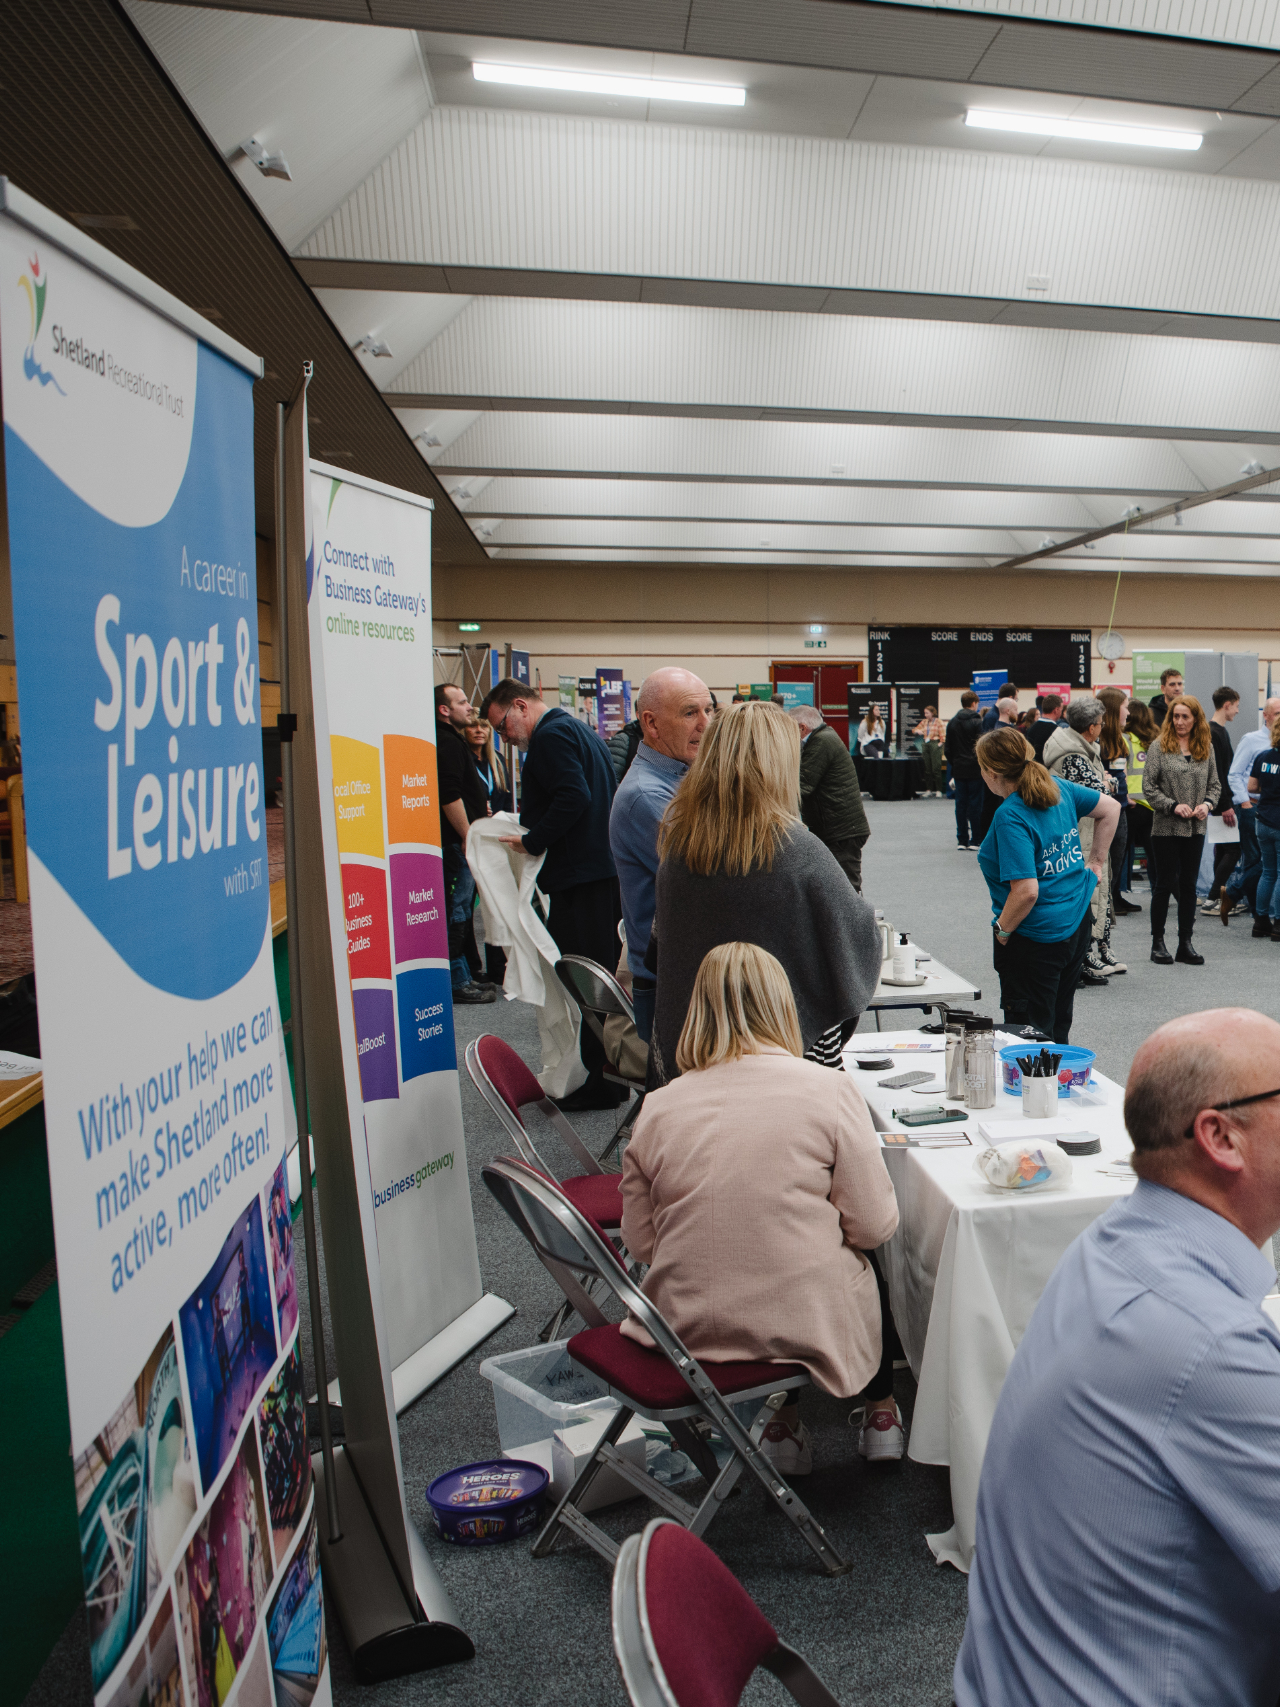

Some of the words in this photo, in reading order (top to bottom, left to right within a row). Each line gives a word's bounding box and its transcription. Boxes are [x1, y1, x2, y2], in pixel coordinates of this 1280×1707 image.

[52, 324, 106, 377] Shetland
[323, 541, 369, 573] Connect
[371, 554, 395, 577] with
[180, 544, 192, 589] A
[194, 557, 238, 597] career
[238, 567, 249, 600] in
[325, 574, 371, 606] Business
[374, 584, 426, 614] Gateway's
[326, 612, 360, 637] online
[362, 619, 415, 643] resources
[869, 631, 891, 641] RINK
[931, 631, 959, 641] SCORE
[970, 631, 994, 642] ENDS
[1006, 632, 1033, 642] SCORE
[877, 642, 882, 651] 1
[1070, 633, 1091, 642] RINK
[877, 652, 883, 662] 2
[1079, 645, 1084, 653] 1
[877, 663, 883, 672] 3
[1079, 654, 1085, 664] 2
[877, 674, 883, 682] 4
[1079, 665, 1085, 674] 3
[94, 594, 224, 766] Sport
[233, 617, 256, 727] &
[1079, 675, 1085, 684] 4
[334, 781, 350, 797] ocal
[350, 779, 371, 794] Office
[402, 773, 427, 788] Market
[107, 734, 261, 880] Leisure
[402, 795, 430, 811] Reports
[338, 804, 365, 822] Support
[1042, 843, 1059, 859] Ask
[1043, 845, 1083, 876] Advis
[224, 866, 249, 898] with
[250, 858, 263, 890] SRT
[347, 891, 364, 909] 100+
[408, 888, 434, 905] Market
[405, 907, 439, 926] Research
[347, 935, 371, 954] Guides
[414, 1002, 444, 1022] Success
[418, 1022, 443, 1041] Stories
[357, 1032, 386, 1056] talBoost
[78, 1083, 133, 1161] With
[136, 1062, 182, 1137] your
[187, 1030, 218, 1090] help
[221, 1021, 247, 1062] we
[251, 1006, 273, 1046] can
[964, 1080, 987, 1088] OOST
[95, 1149, 151, 1230] make
[154, 1079, 228, 1179] Shetland
[233, 1063, 273, 1116] more
[111, 1210, 173, 1293] active,
[178, 1163, 220, 1230] more
[223, 1113, 270, 1184] often!
[462, 1472, 521, 1484] HEROES
